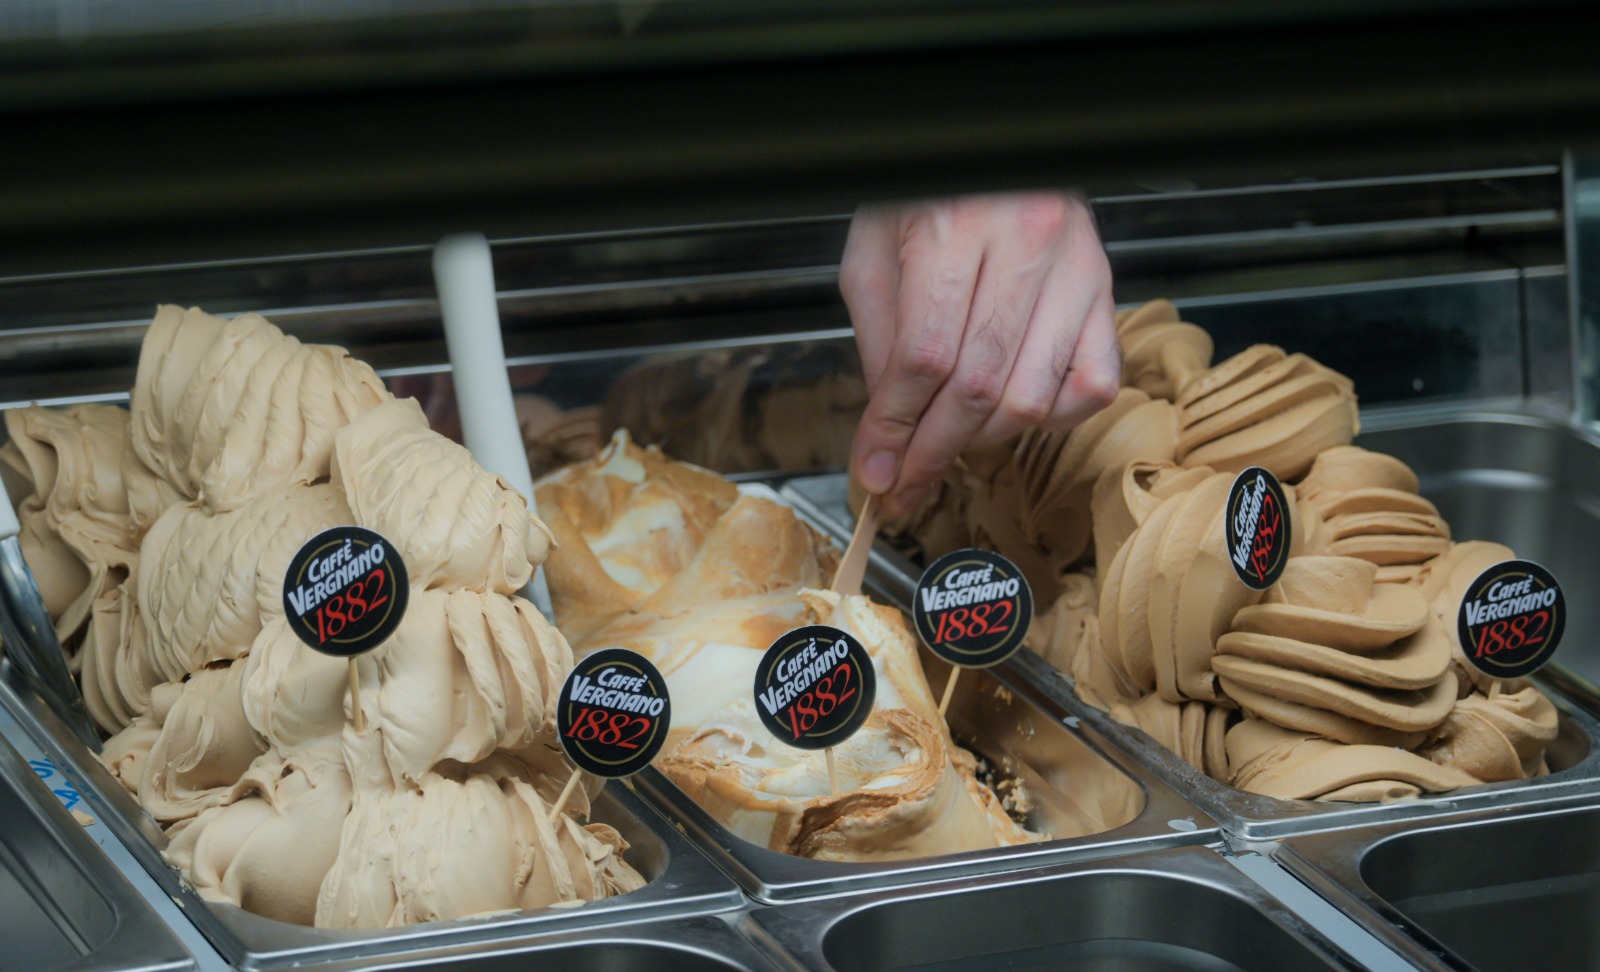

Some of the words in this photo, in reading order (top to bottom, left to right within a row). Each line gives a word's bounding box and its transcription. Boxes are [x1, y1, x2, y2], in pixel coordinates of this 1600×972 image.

[1233, 474, 1266, 571] VERGNANO
[1234, 484, 1252, 537] CAFFÈ
[307, 538, 353, 583] CAFFÈ
[1251, 494, 1280, 582] 1882
[287, 543, 385, 617] VERGNANO
[921, 577, 1020, 613] VERGNANO
[944, 563, 994, 589] CAFFÈ
[1487, 573, 1534, 602] CAFFÈ
[316, 569, 388, 644] 1882
[933, 600, 1013, 644] 1882
[1465, 587, 1557, 627] VERGNANO
[1474, 610, 1549, 658] 1882
[597, 667, 648, 693] CAFFÈ
[758, 639, 849, 716] VERGNANO
[776, 637, 818, 683] CAFFÈ
[569, 674, 665, 717] VERGNANO
[787, 663, 857, 741] 1882
[565, 707, 651, 749] 1882
